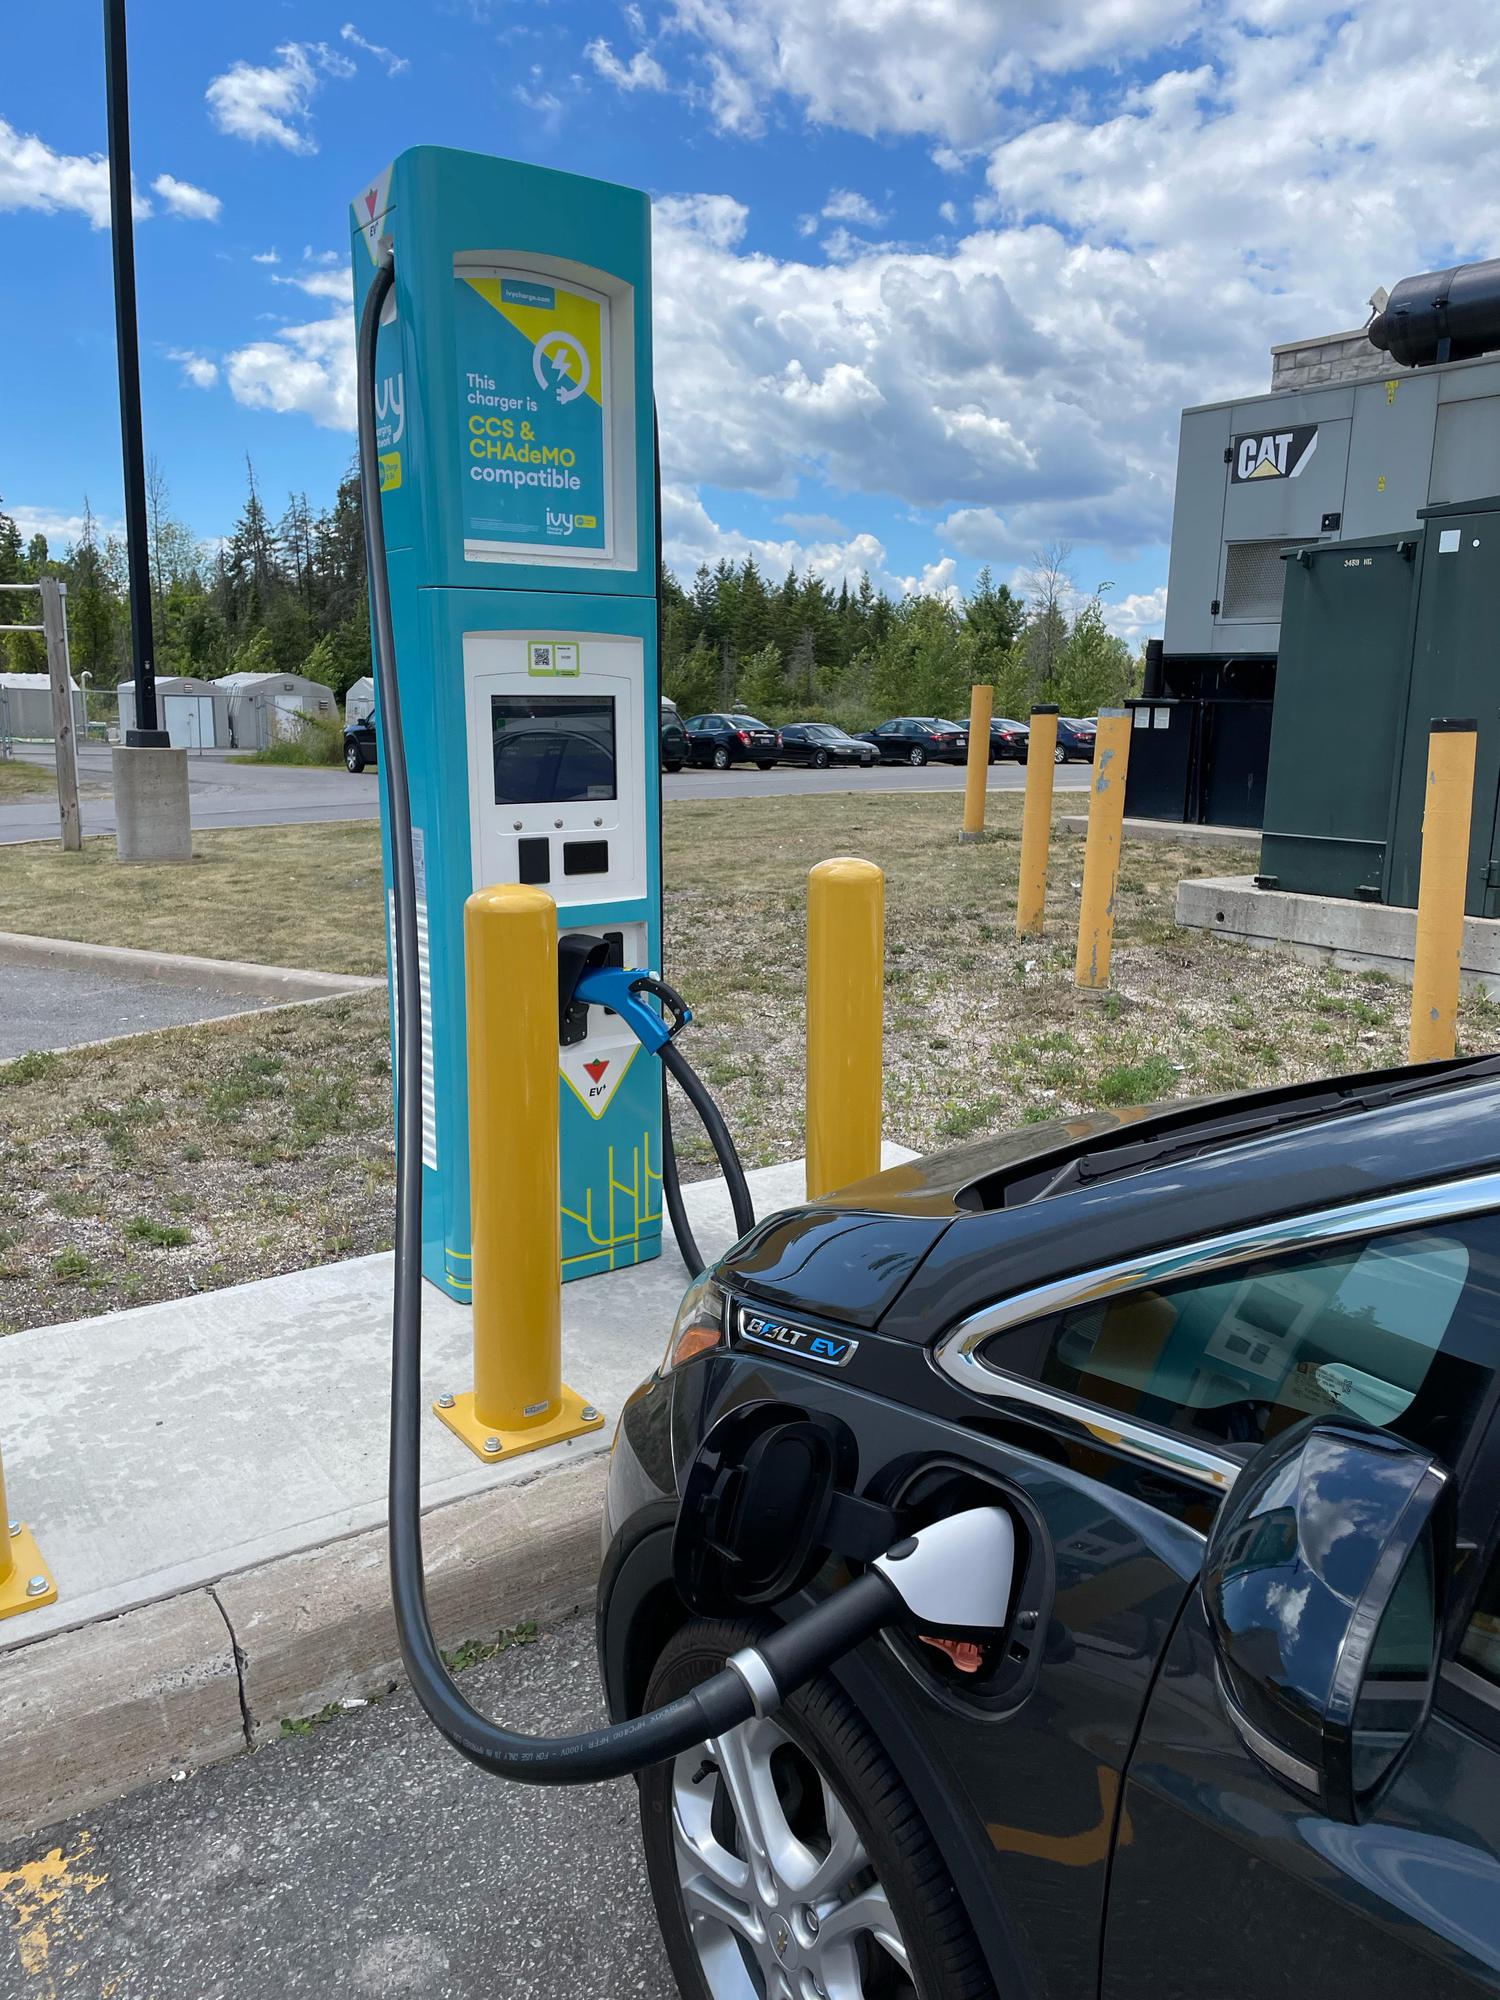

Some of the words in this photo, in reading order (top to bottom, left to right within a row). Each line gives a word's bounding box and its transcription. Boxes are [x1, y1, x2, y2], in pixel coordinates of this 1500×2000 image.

[466, 373, 496, 390] This
[375, 373, 404, 444] vy
[467, 390, 523, 412] charger
[526, 396, 538, 411] is
[468, 415, 514, 438] CCS
[520, 421, 535, 440] &
[469, 438, 576, 467] CHAdeMO
[1238, 433, 1293, 479] CAT
[470, 466, 581, 490] compatible
[546, 507, 573, 535] ivy
[746, 1318, 807, 1345] BOLT
[810, 1337, 845, 1357] EV
[536, 1751, 549, 1760] FOR
